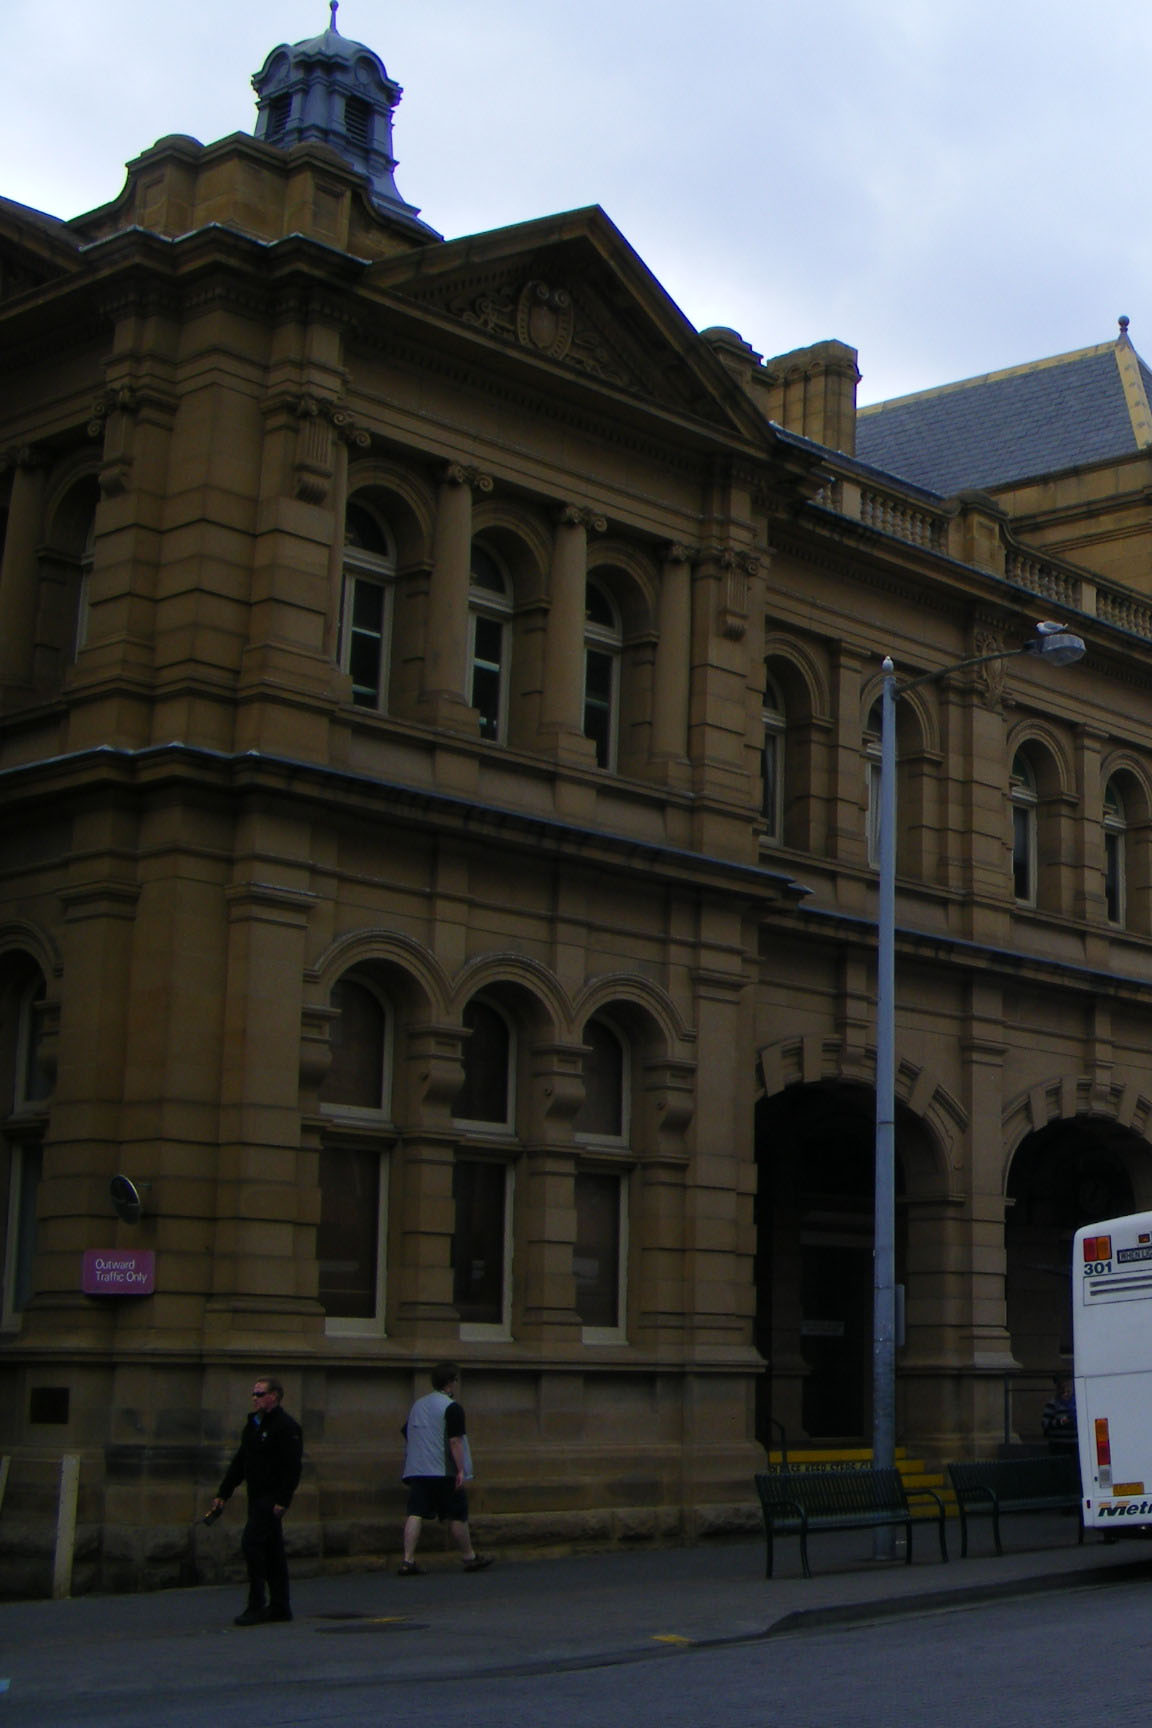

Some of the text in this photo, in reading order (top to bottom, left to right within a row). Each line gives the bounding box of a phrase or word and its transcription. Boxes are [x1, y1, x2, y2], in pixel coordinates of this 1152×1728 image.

[1119, 1249, 1141, 1261] WHEN
[95, 1258, 135, 1270] Outward
[1083, 1261, 1112, 1275] 301
[95, 1271, 148, 1284] Traffic Only
